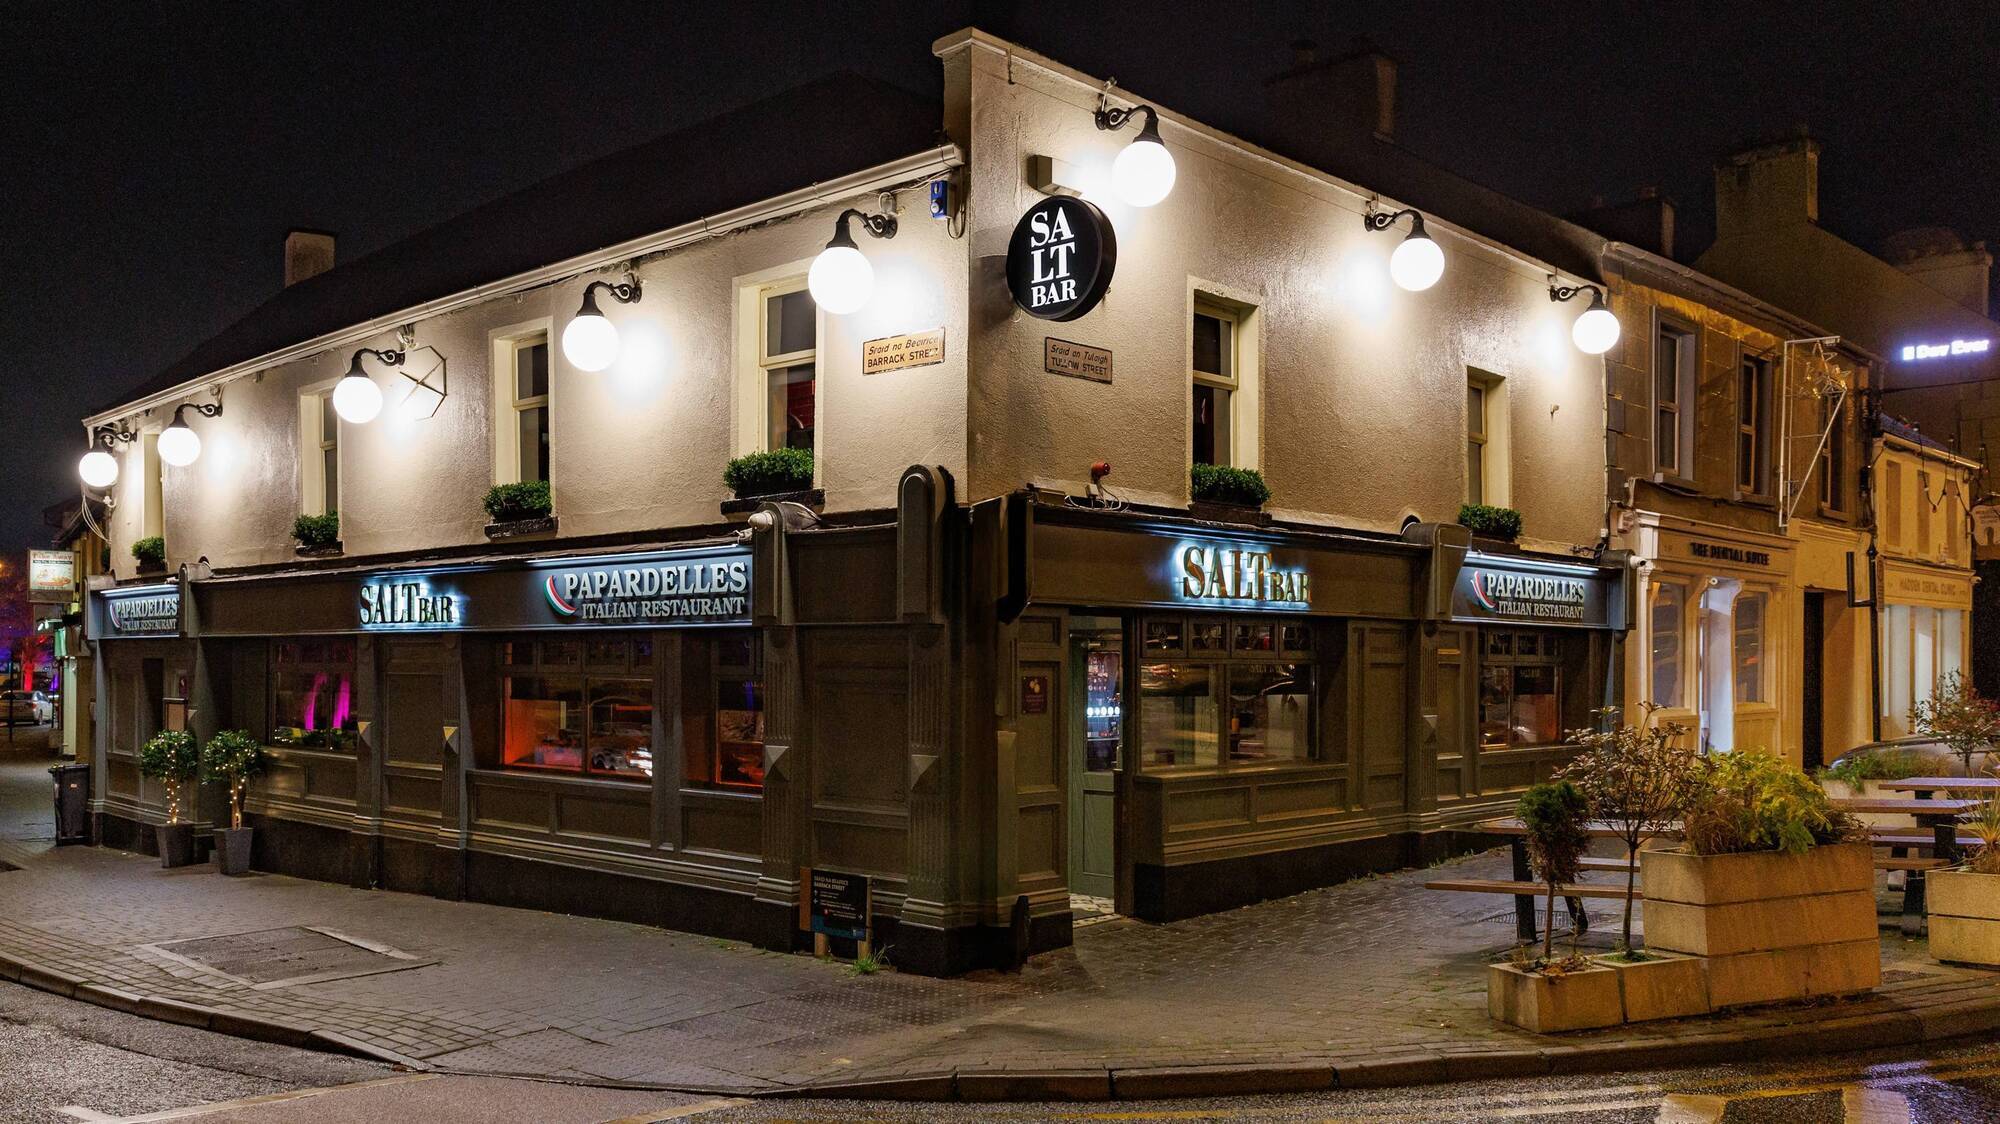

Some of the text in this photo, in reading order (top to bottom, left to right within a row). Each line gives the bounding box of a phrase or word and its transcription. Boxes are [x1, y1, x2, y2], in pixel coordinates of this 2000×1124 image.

[1030, 278, 1078, 308] BAR
[892, 343, 903, 351] na
[1072, 350, 1081, 359] an
[867, 353, 905, 368] BARRACK
[1082, 363, 1107, 376] STREET
[1690, 542, 1709, 558] THE
[1710, 545, 1744, 563] DENTAL
[1745, 550, 1770, 566] SUITE
[564, 561, 748, 600] PAPARDELLES
[1183, 545, 1313, 603] SALT BAR
[1486, 573, 1585, 603] PAPARDELLES
[115, 597, 178, 619] PAPARDELLES
[360, 582, 454, 625] SALT BAR
[581, 596, 745, 620] ITALIAN RESTAURANT
[1498, 600, 1585, 619] ITALIAN RESTAURANT
[140, 618, 177, 632] RESTAURANT
